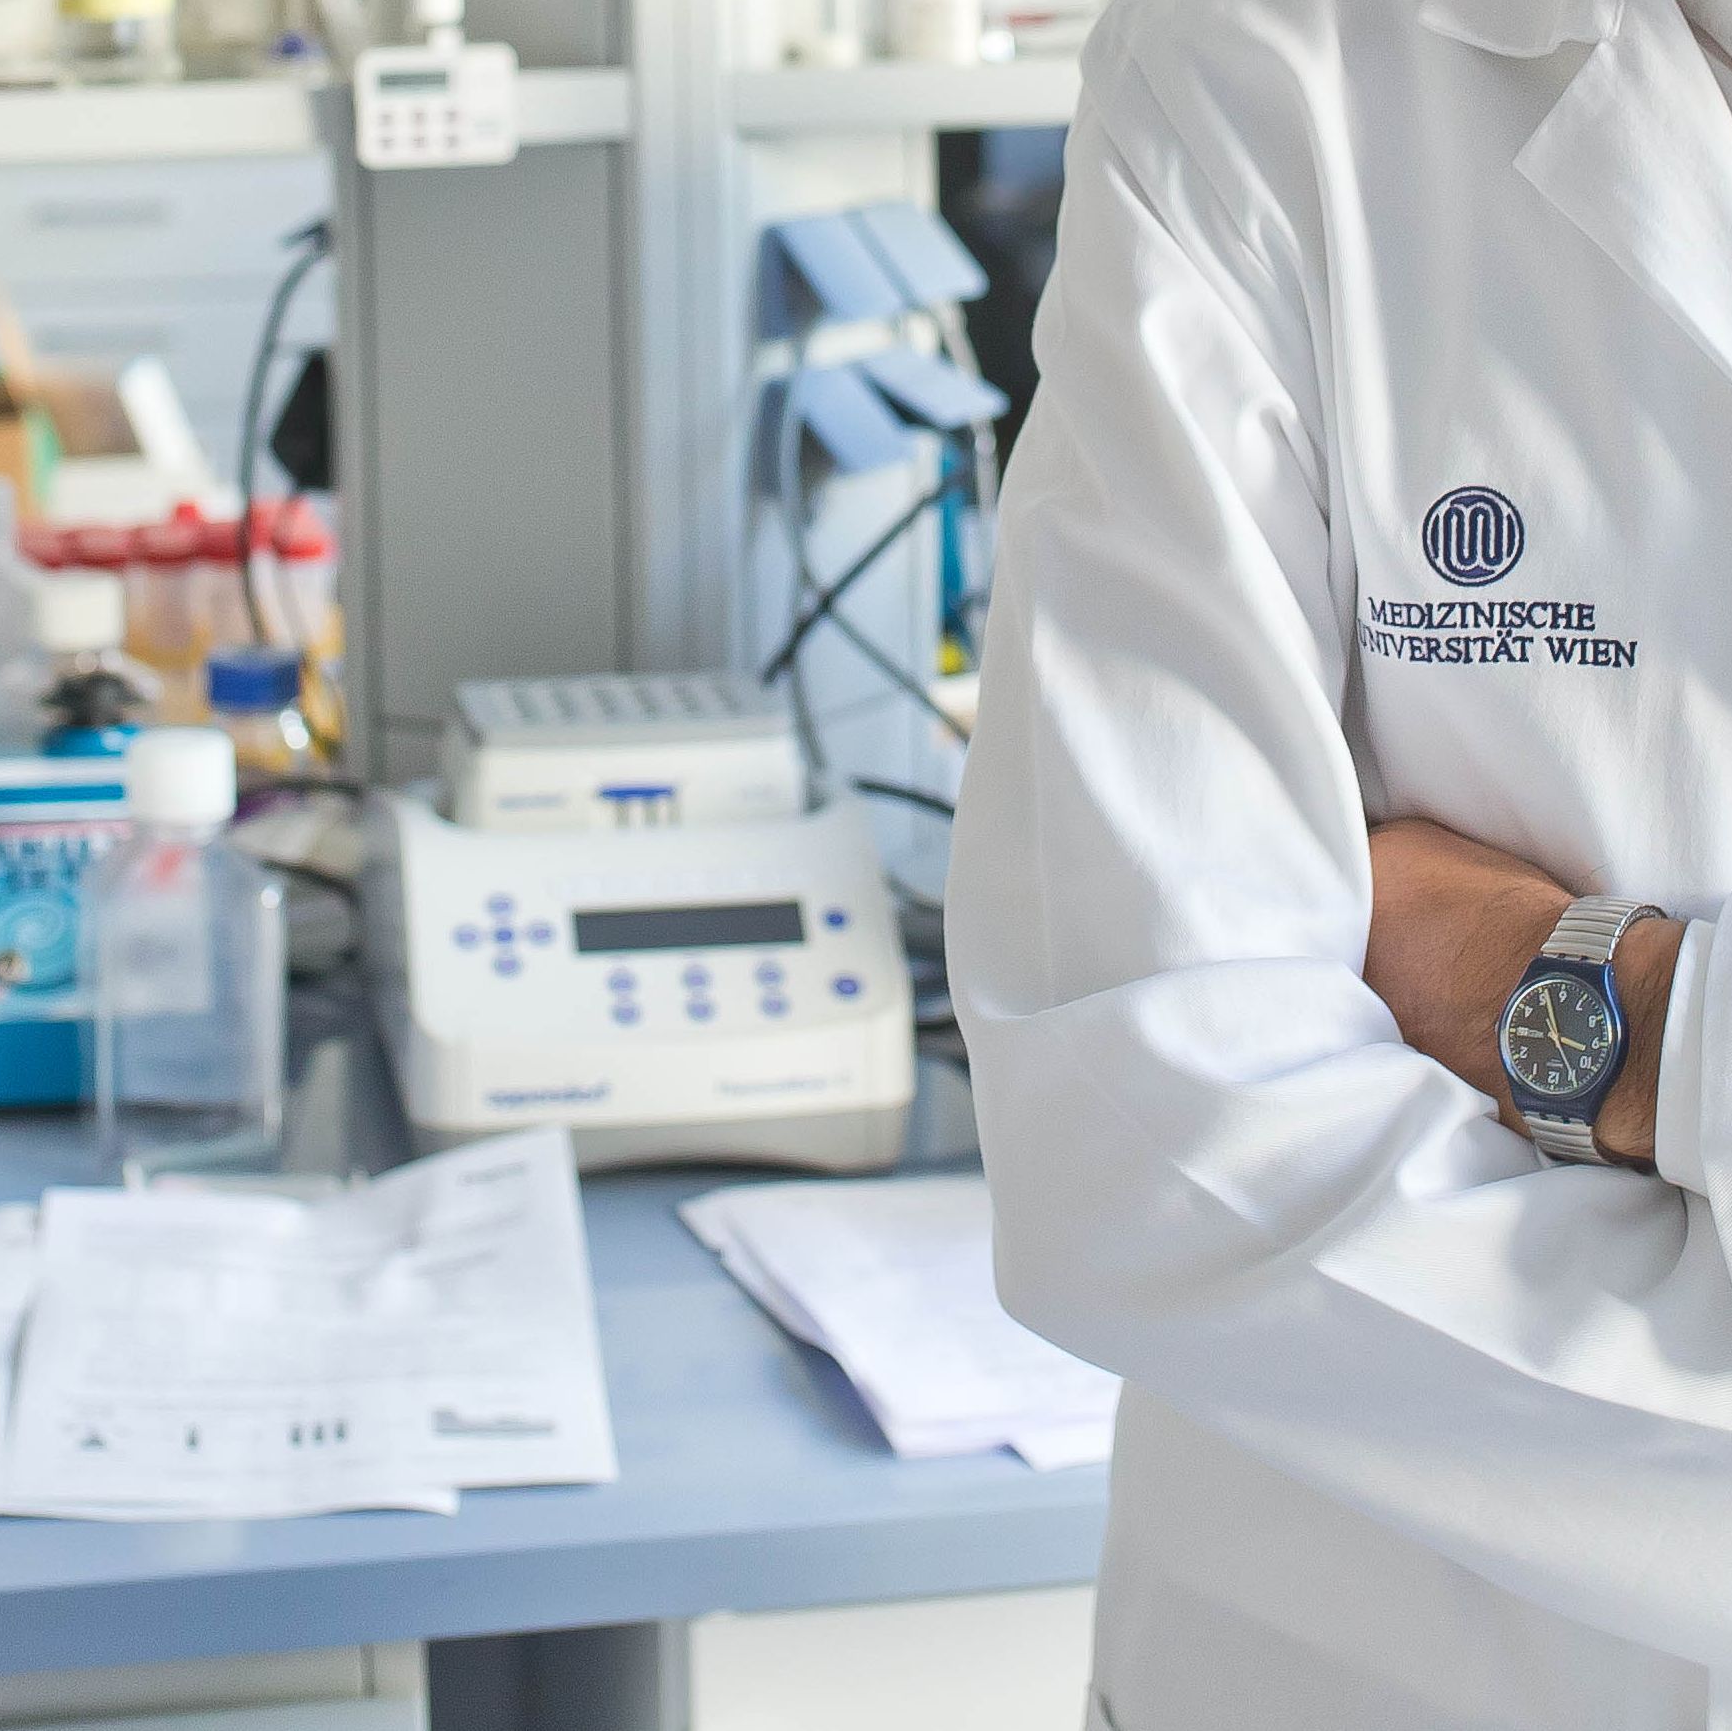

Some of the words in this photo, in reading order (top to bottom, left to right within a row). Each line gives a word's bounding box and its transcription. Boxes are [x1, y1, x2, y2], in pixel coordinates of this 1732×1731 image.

[1368, 597, 1595, 631] MEDIZINISCHE
[1544, 636, 1638, 668] WIEN
[1559, 990, 1567, 1003] 6
[1524, 1006, 1533, 1018] 4
[1575, 1000, 1583, 1011] 7
[1588, 1015, 1596, 1028] 8
[1592, 1037, 1599, 1049] 9
[1519, 1046, 1528, 1059] 2
[1579, 1055, 1592, 1069] 10
[1547, 1071, 1559, 1084] 12
